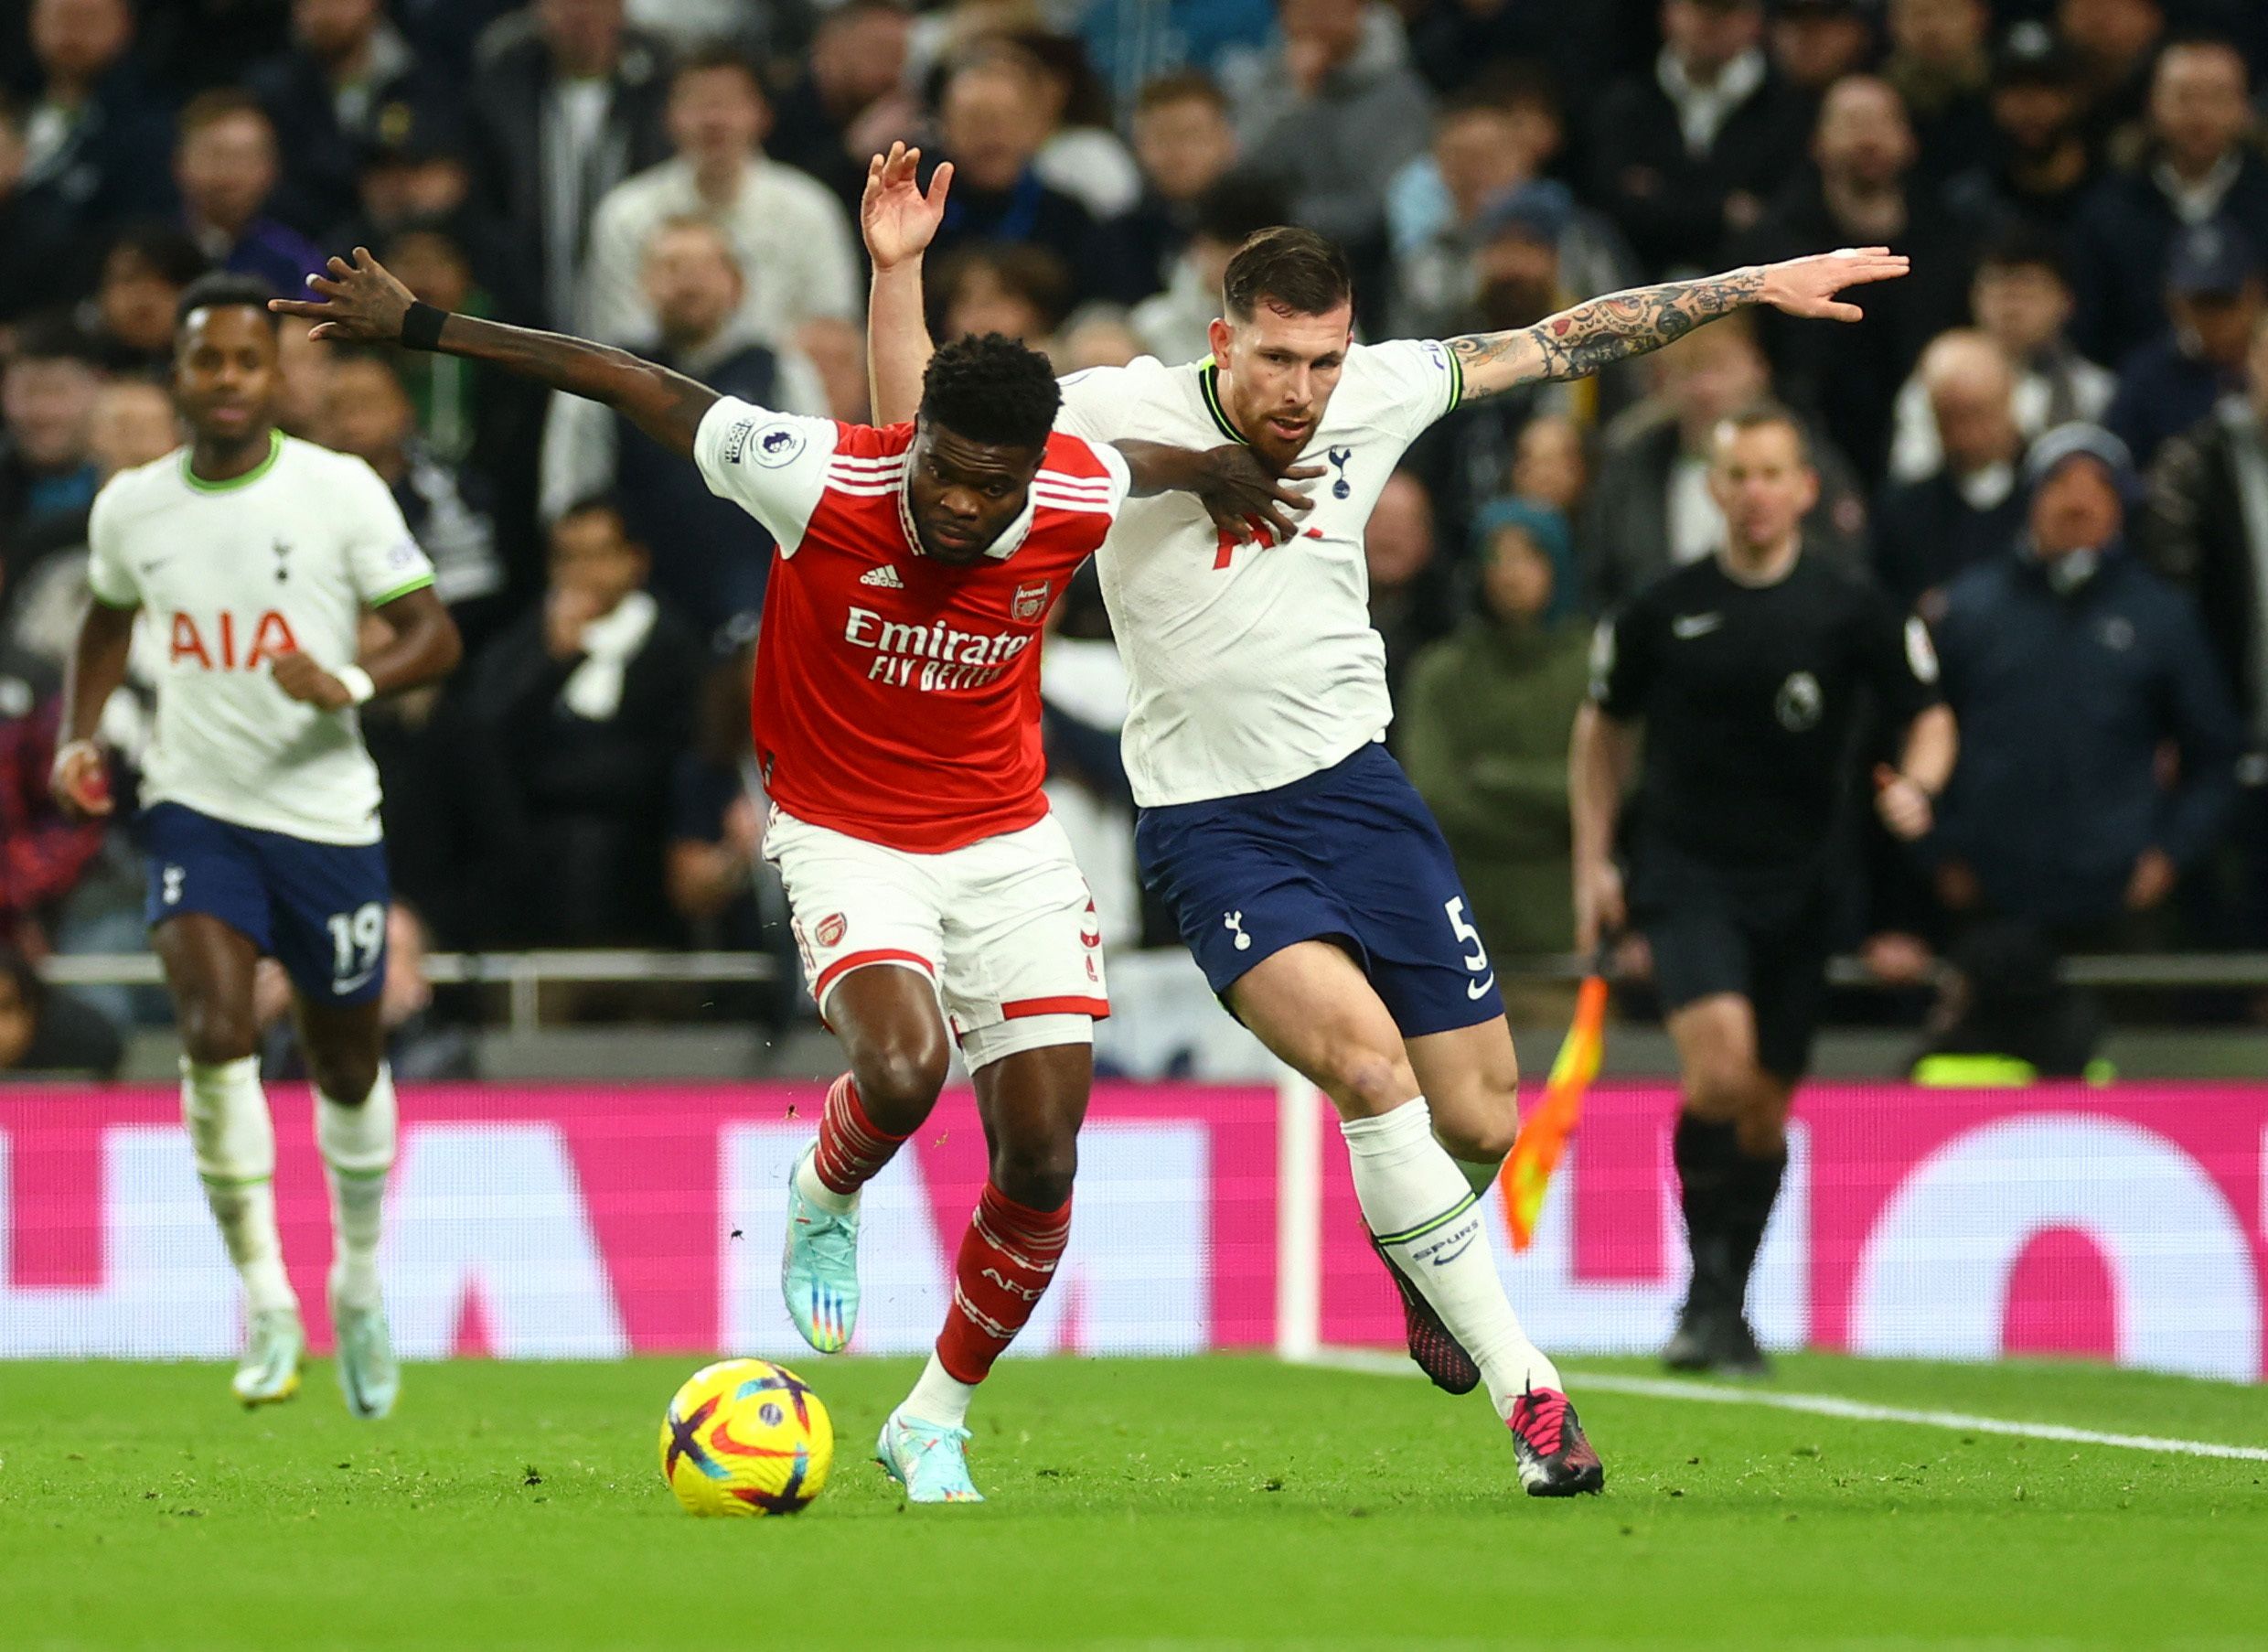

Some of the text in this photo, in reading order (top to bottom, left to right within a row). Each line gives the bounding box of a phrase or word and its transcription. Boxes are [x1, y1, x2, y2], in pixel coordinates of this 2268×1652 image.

[860, 574, 904, 589] adidas
[1017, 585, 1048, 598] Arsenal
[170, 609, 298, 670] AIA
[845, 606, 1033, 665] Emirate
[868, 655, 916, 687] FLY
[326, 901, 384, 978] 19
[1445, 896, 1488, 971] 5
[1412, 1219, 1479, 1260] SPURS
[981, 1268, 1045, 1301] AFC
